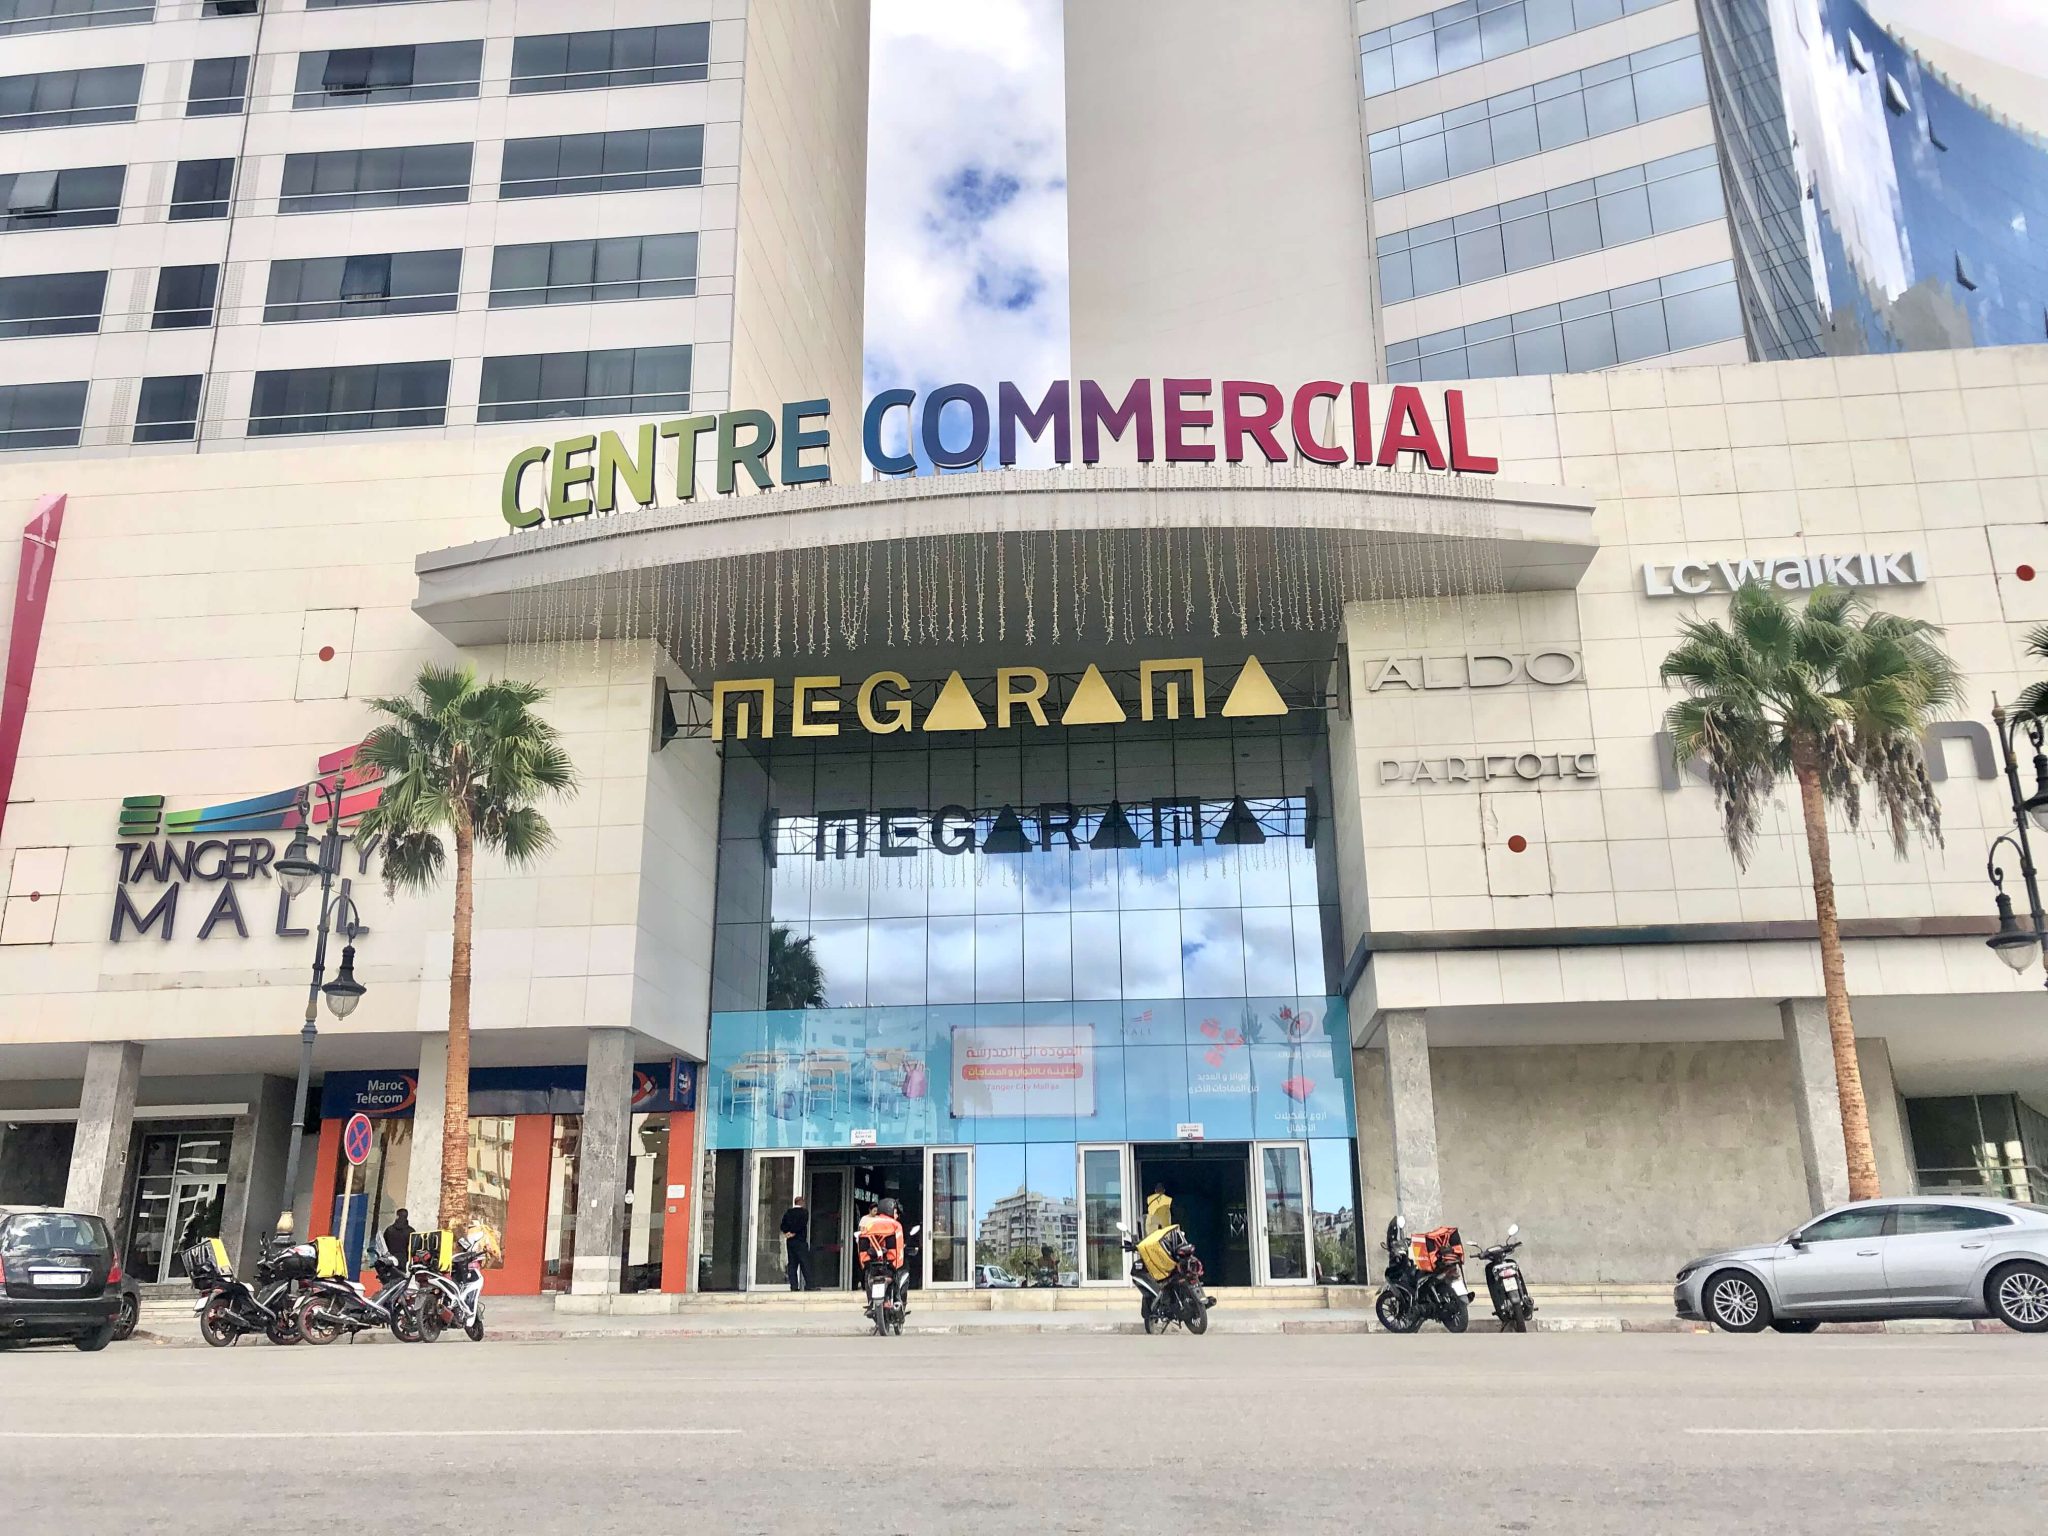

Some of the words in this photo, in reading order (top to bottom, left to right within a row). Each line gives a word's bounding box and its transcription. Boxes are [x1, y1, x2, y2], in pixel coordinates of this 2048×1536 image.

[501, 398, 831, 529] CENTRE
[862, 378, 1499, 476] COMMERCIAL
[1643, 559, 1713, 597] LC
[1369, 648, 1583, 692] ALDO
[711, 654, 1289, 743] MEGARAMA
[1379, 751, 1599, 785] PARFOIS
[115, 837, 275, 885] TANGER
[109, 877, 370, 942] MALL
[965, 1045, 1017, 1060] المدرسة
[355, 1092, 403, 1104] Telecom
[367, 1079, 405, 1091] Maroc
[1227, 1212, 1248, 1225] TAN
